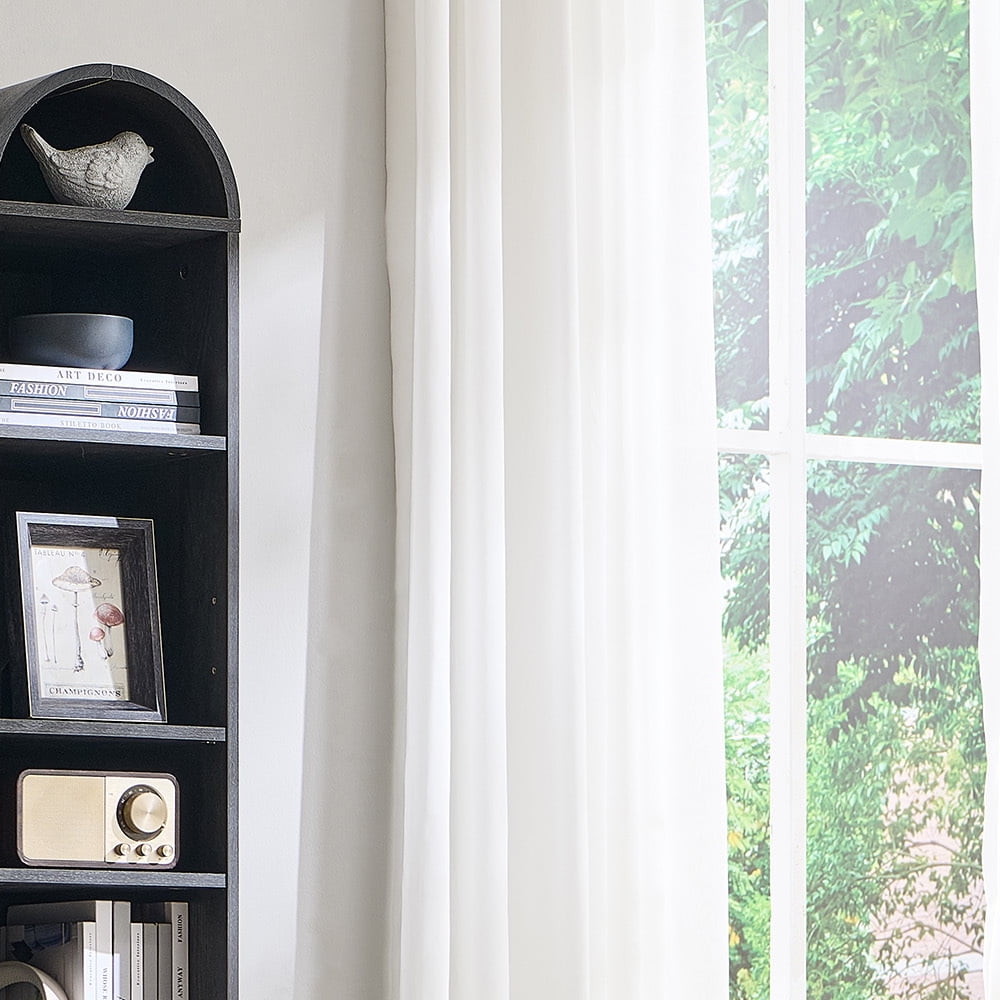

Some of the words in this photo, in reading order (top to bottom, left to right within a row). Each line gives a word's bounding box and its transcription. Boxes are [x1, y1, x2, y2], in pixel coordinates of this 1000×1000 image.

[56, 370, 81, 380] ART
[88, 372, 122, 382] DECO
[10, 382, 68, 396] FASHION
[117, 405, 176, 420] FASHION
[60, 419, 98, 428] STILETTO
[49, 687, 121, 697] CHAMPIGNONS
